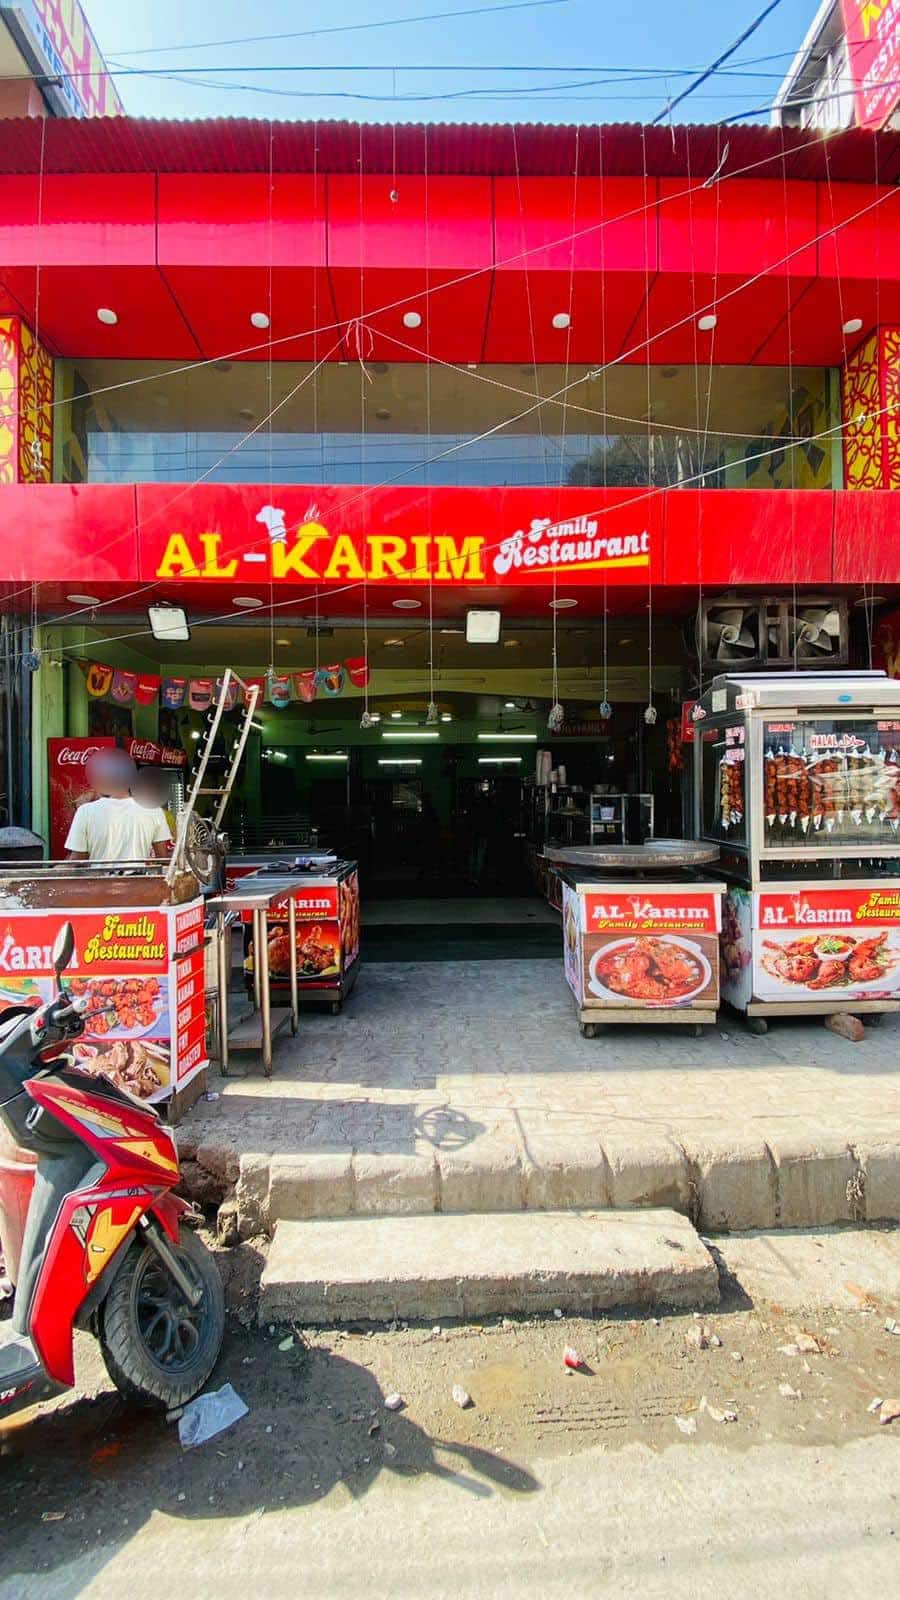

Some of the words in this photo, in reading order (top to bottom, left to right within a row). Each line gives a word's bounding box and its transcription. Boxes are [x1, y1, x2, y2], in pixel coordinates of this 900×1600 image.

[528, 516, 598, 544] Family
[156, 521, 485, 580] AL-KARIM
[493, 529, 650, 575] Restaurant
[810, 734, 838, 748] HALAL
[869, 892, 900, 907] Famil
[103, 915, 155, 942] Family
[598, 920, 638, 929] Family
[641, 920, 704, 929] Restaurant
[84, 935, 165, 964] Restaurant
